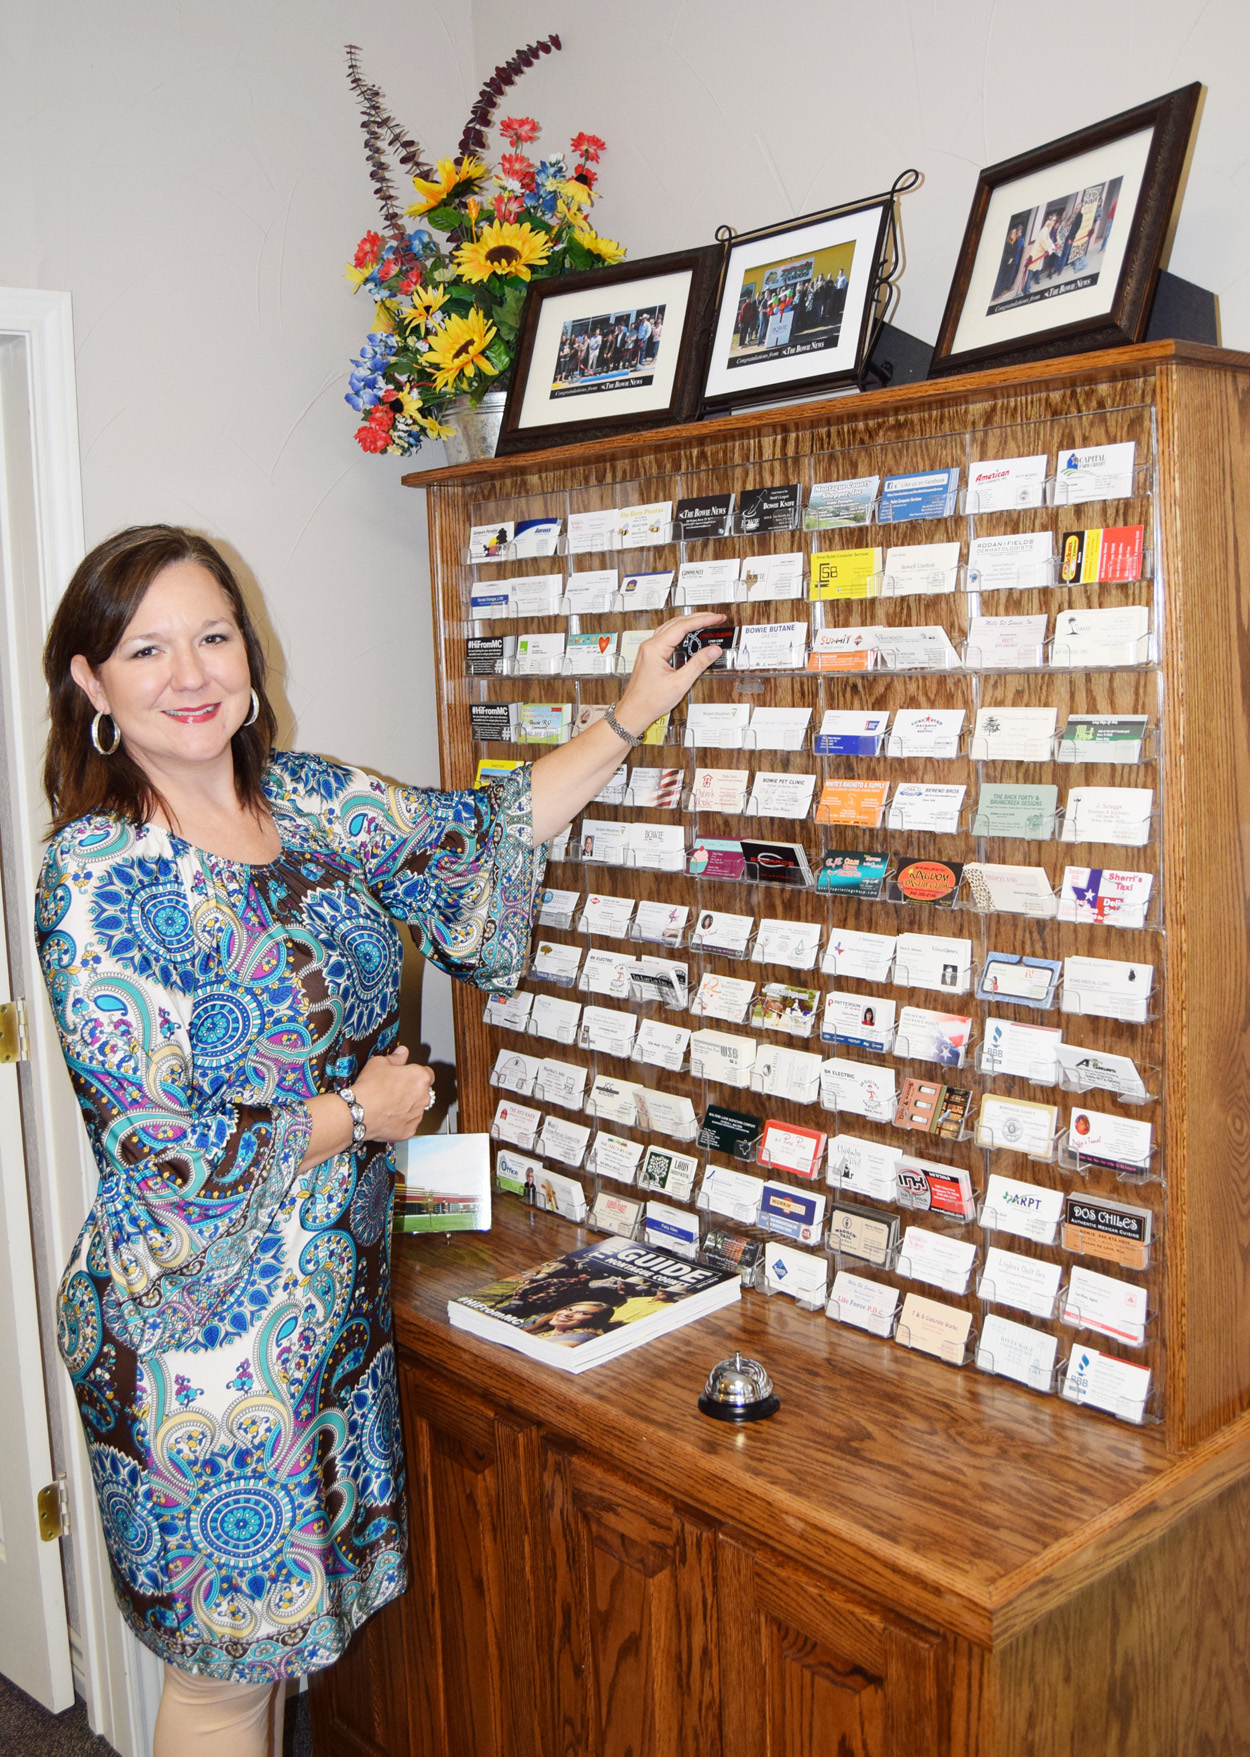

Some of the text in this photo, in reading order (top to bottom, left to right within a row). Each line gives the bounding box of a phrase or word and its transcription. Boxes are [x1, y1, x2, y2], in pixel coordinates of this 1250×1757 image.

[1059, 284, 1076, 294] BOWIE
[1076, 279, 1091, 289] NEWS
[736, 341, 824, 364] Congratulations from THE BOWIE NEWS
[555, 387, 588, 397] Congratulations
[605, 382, 615, 390] THE
[615, 380, 629, 389] BOWIE
[629, 378, 643, 387] NEWS
[975, 470, 1010, 483] American
[813, 484, 848, 494] Montague
[763, 500, 795, 510] BOWIE KNIFE
[684, 506, 727, 519] THE BOWIE NEWS
[1007, 539, 1034, 547] FIELDS
[745, 624, 795, 634] BOWIE BUTANE
[467, 639, 503, 649] #HiFromMC
[472, 706, 508, 716] #HiFromMC
[644, 830, 664, 839] BOWIE
[909, 870, 949, 881] KINGDOM
[1109, 872, 1143, 883] Sherri's
[1116, 882, 1133, 891] Taxi
[834, 1000, 861, 1009] PATTERSON
[987, 1048, 1003, 1058] BBB
[832, 1070, 855, 1079] ELECTRIC
[500, 1162, 519, 1176] Office
[1074, 1206, 1138, 1231] DOS CHILES
[1071, 1218, 1097, 1228] AUTHENTIC
[1098, 1224, 1118, 1233] MEXICAN
[1119, 1230, 1140, 1239] CUISINE
[605, 1258, 692, 1287] MONTAGUE COUNTY
[617, 1248, 714, 1284] GUIDE
[837, 1295, 849, 1305] Life
[849, 1299, 867, 1311] Force
[457, 1296, 524, 1325] #HiFromMC
[926, 1315, 944, 1326] Concrete
[944, 1322, 958, 1331] Works
[1070, 1374, 1089, 1388] BBB
